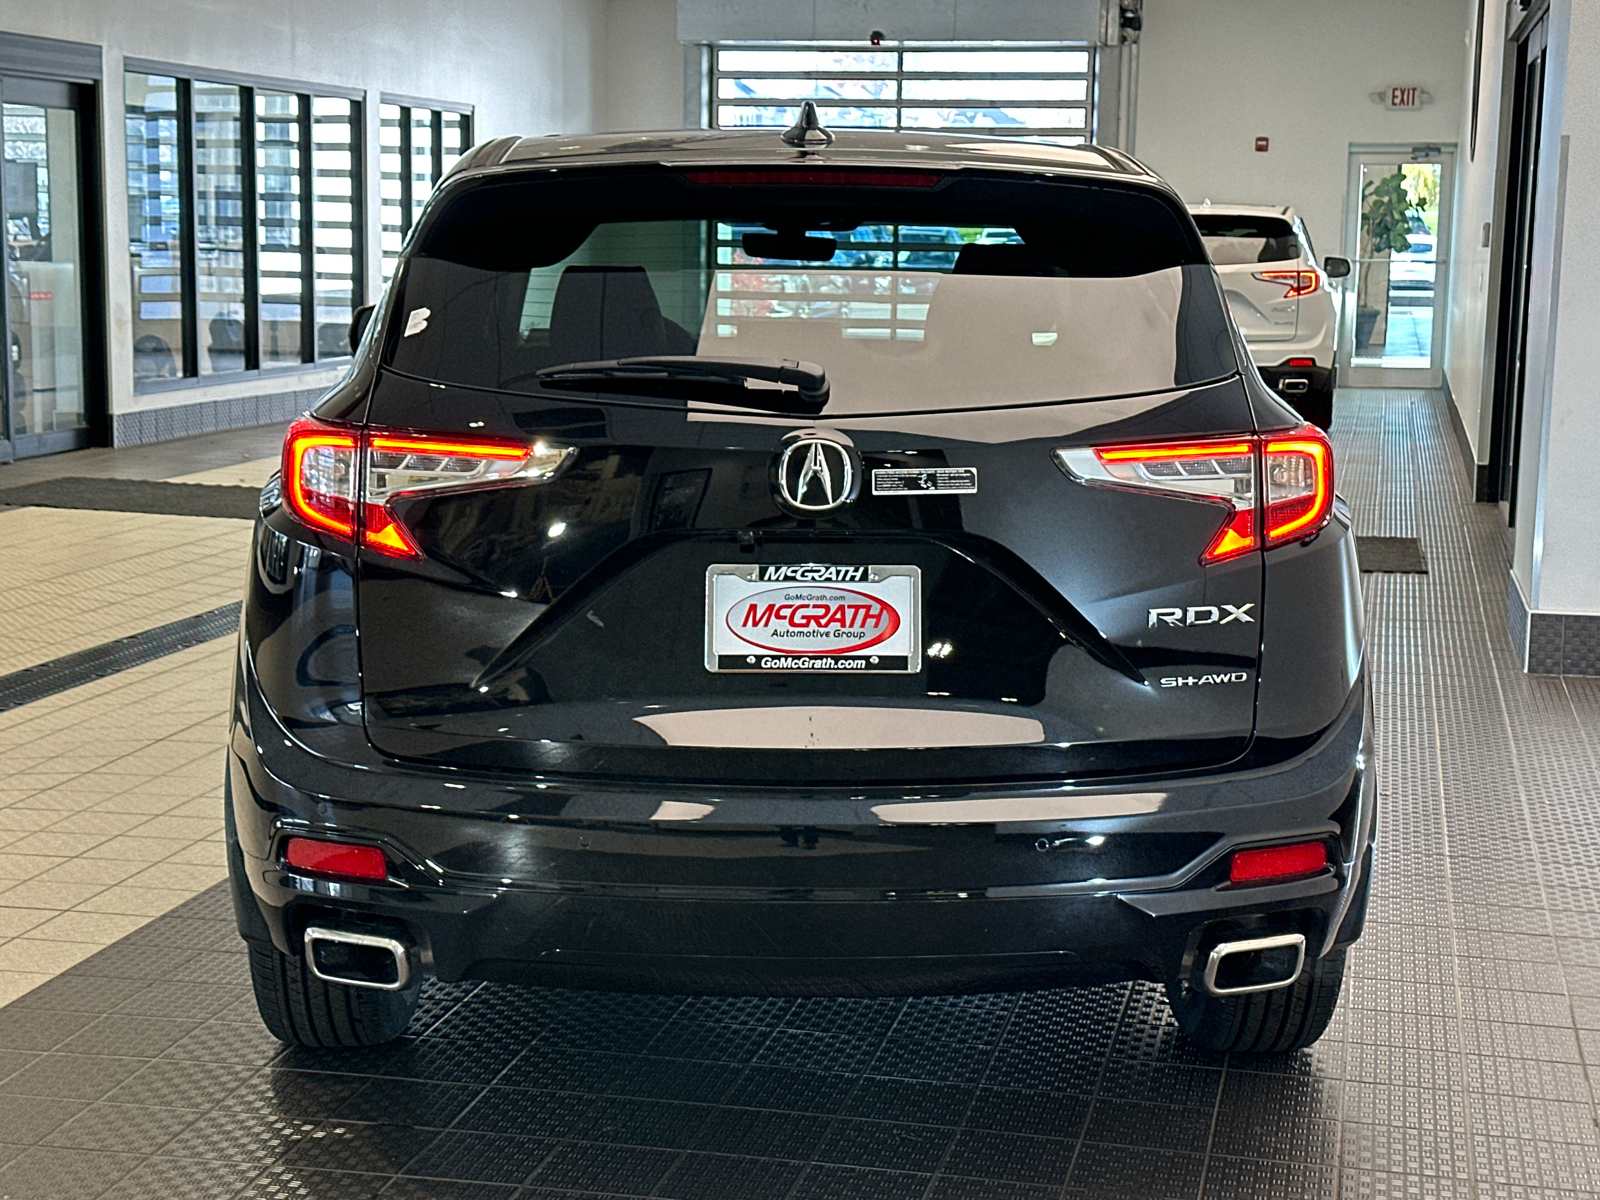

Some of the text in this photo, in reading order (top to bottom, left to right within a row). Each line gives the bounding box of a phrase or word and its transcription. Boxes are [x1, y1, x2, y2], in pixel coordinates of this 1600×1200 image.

[1391, 88, 1417, 106] EXIT
[784, 594, 845, 602] GoMcGrath.com
[1148, 603, 1255, 628] RDX
[771, 629, 866, 640] Automotive Group
[761, 657, 865, 669] GoMcGrath.com
[1160, 672, 1247, 687] SH-AWD
